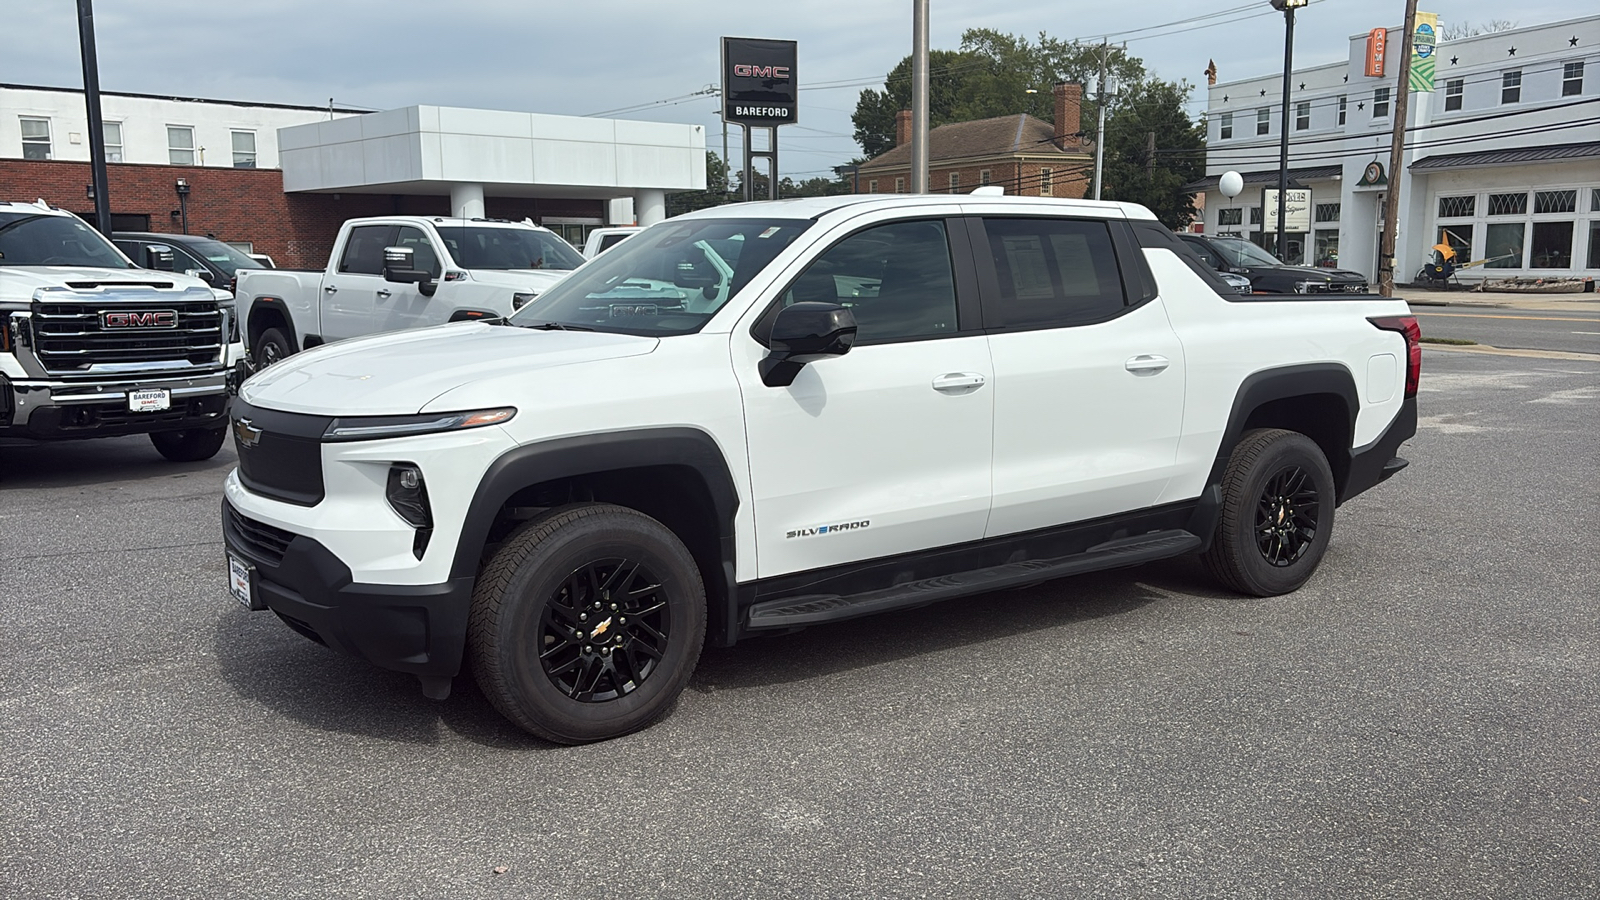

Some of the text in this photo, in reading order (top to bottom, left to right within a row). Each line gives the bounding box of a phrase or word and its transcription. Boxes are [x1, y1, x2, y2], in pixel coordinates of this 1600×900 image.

[1375, 31, 1383, 73] ACME
[734, 64, 789, 78] GMC
[736, 106, 788, 117] BAREFORD
[106, 313, 174, 326] GMC
[786, 520, 870, 538] SILVERADO
